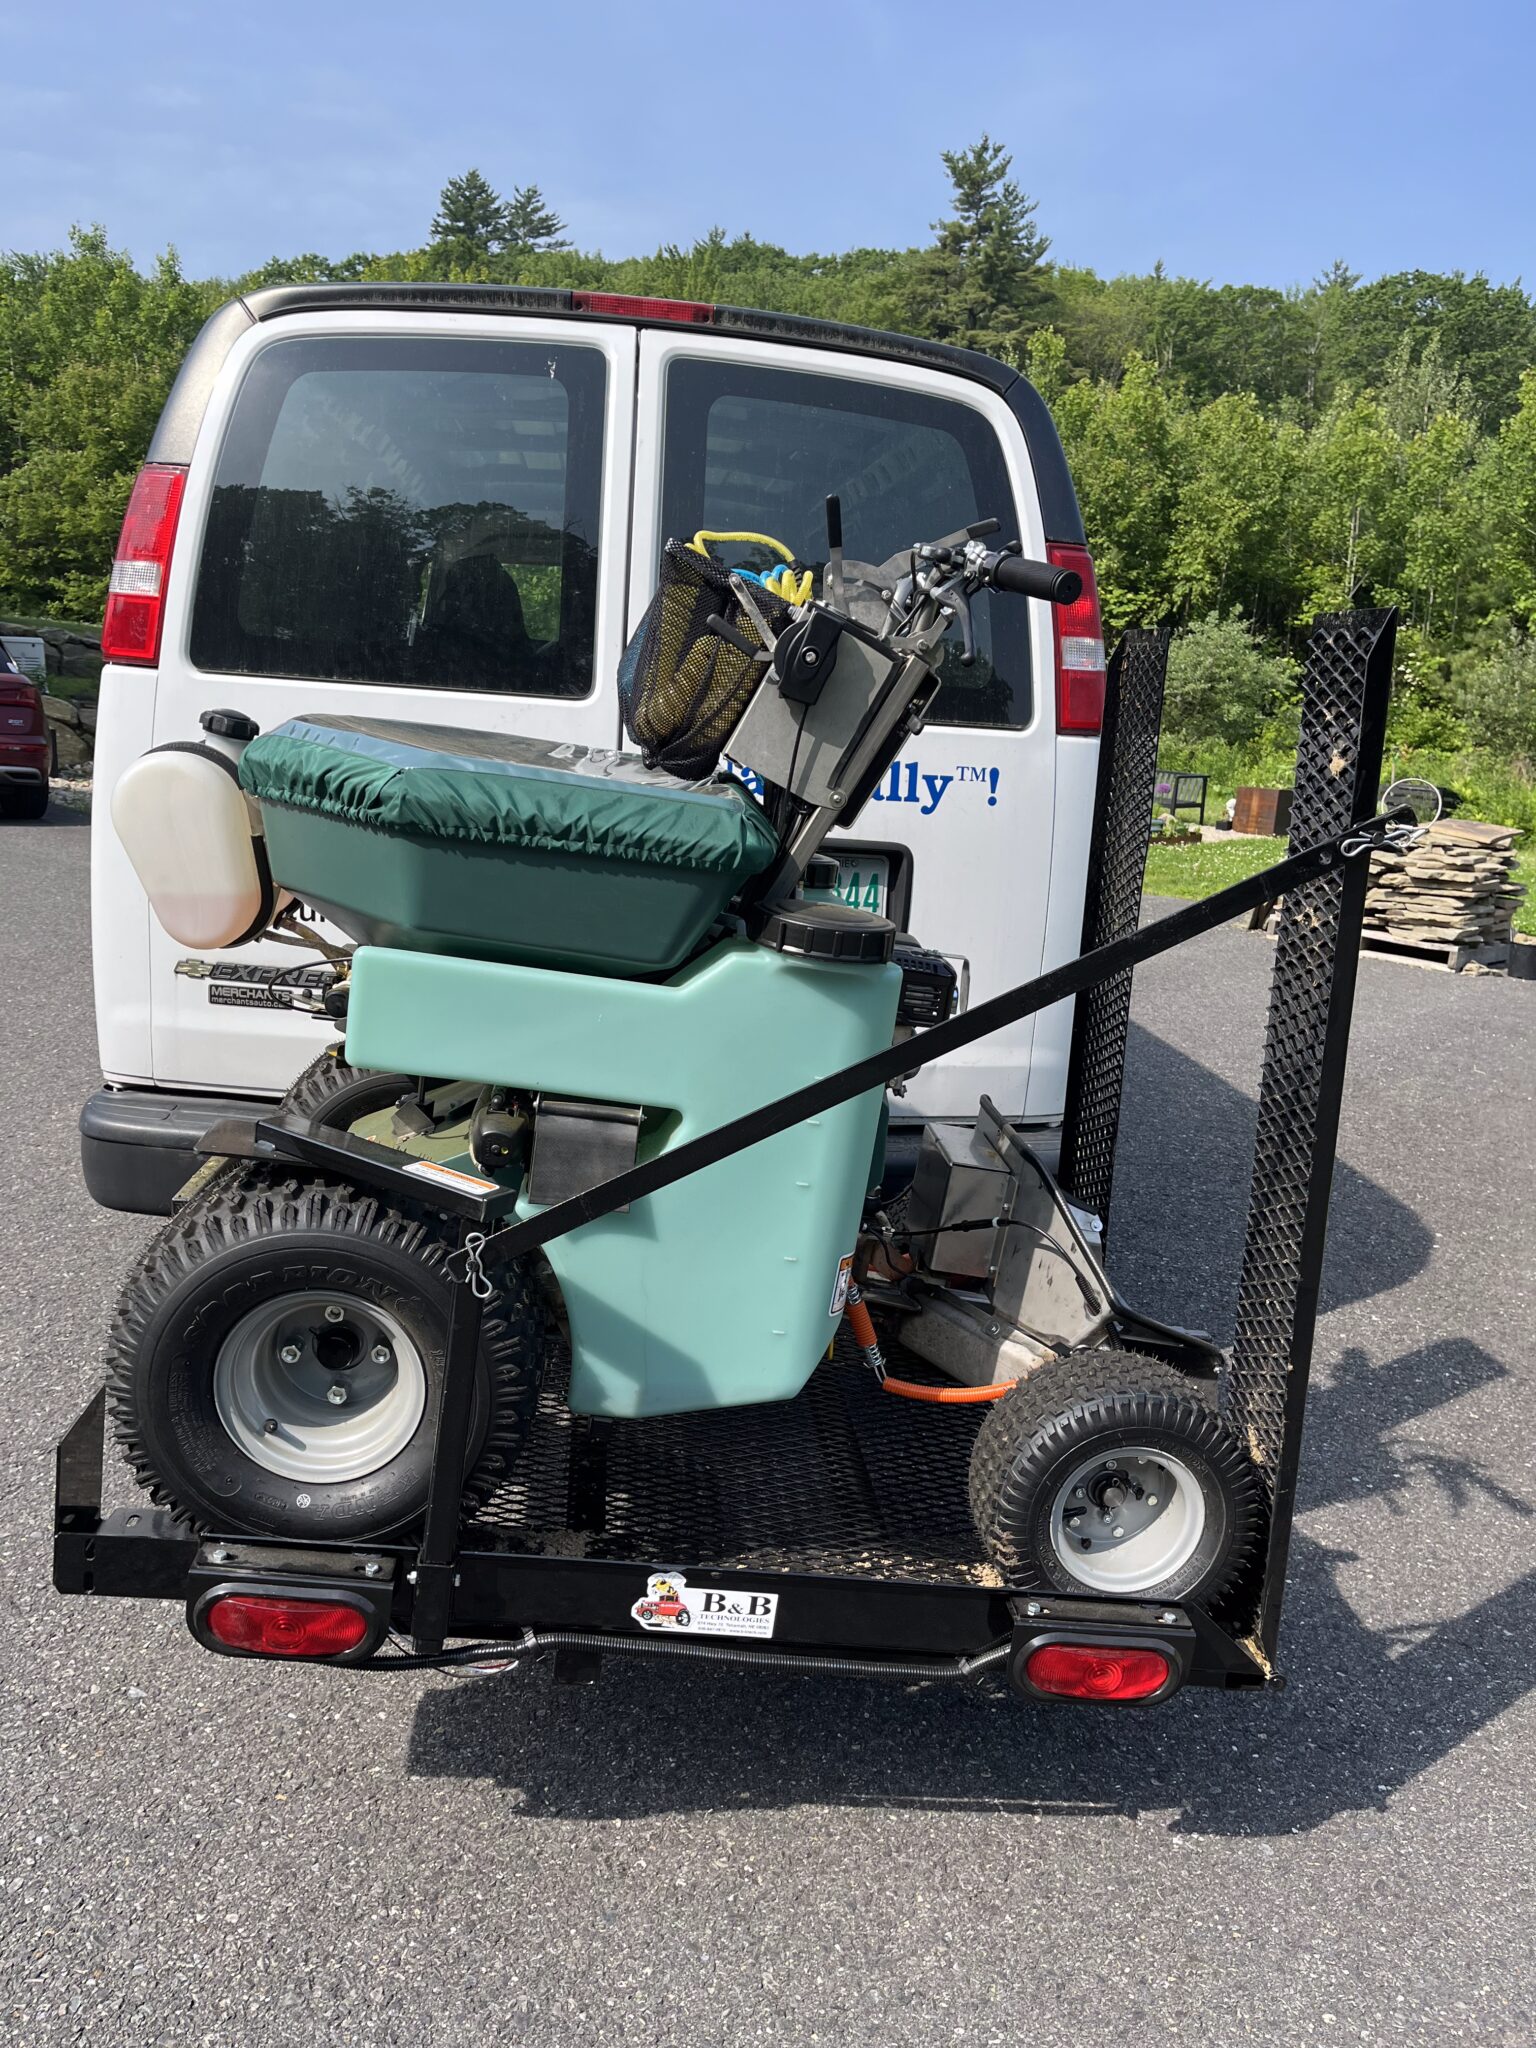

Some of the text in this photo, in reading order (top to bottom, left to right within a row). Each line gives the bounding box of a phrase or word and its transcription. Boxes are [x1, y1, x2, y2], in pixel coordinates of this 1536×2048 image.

[211, 986, 290, 1001] MERCHANTS
[211, 996, 288, 1008] merchantsauto.c
[699, 1592, 772, 1616] B&B
[700, 1613, 770, 1624] TECHNOLOGIES
